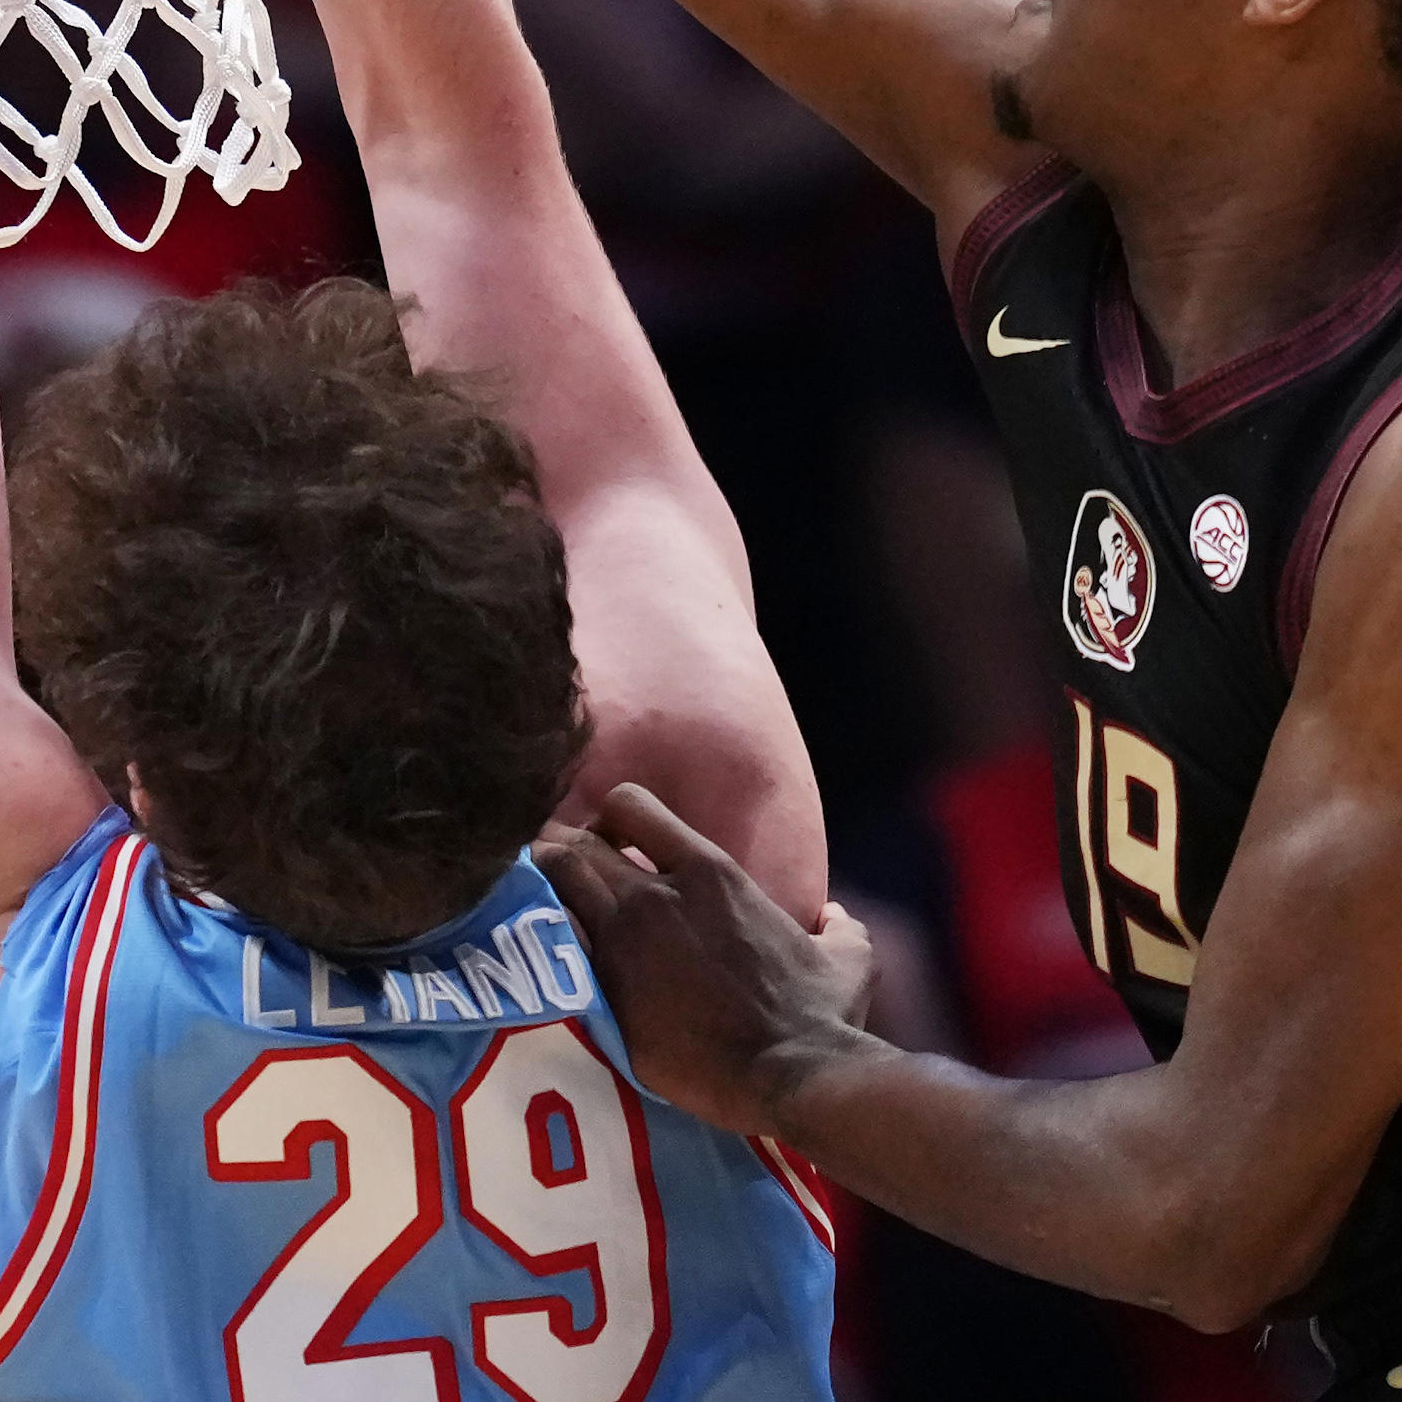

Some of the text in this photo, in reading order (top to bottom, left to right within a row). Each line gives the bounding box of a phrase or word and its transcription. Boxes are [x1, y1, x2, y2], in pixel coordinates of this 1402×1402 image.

[1201, 526, 1245, 563] ACC
[1068, 690, 1202, 987] 19
[203, 1016, 672, 1402] 29
